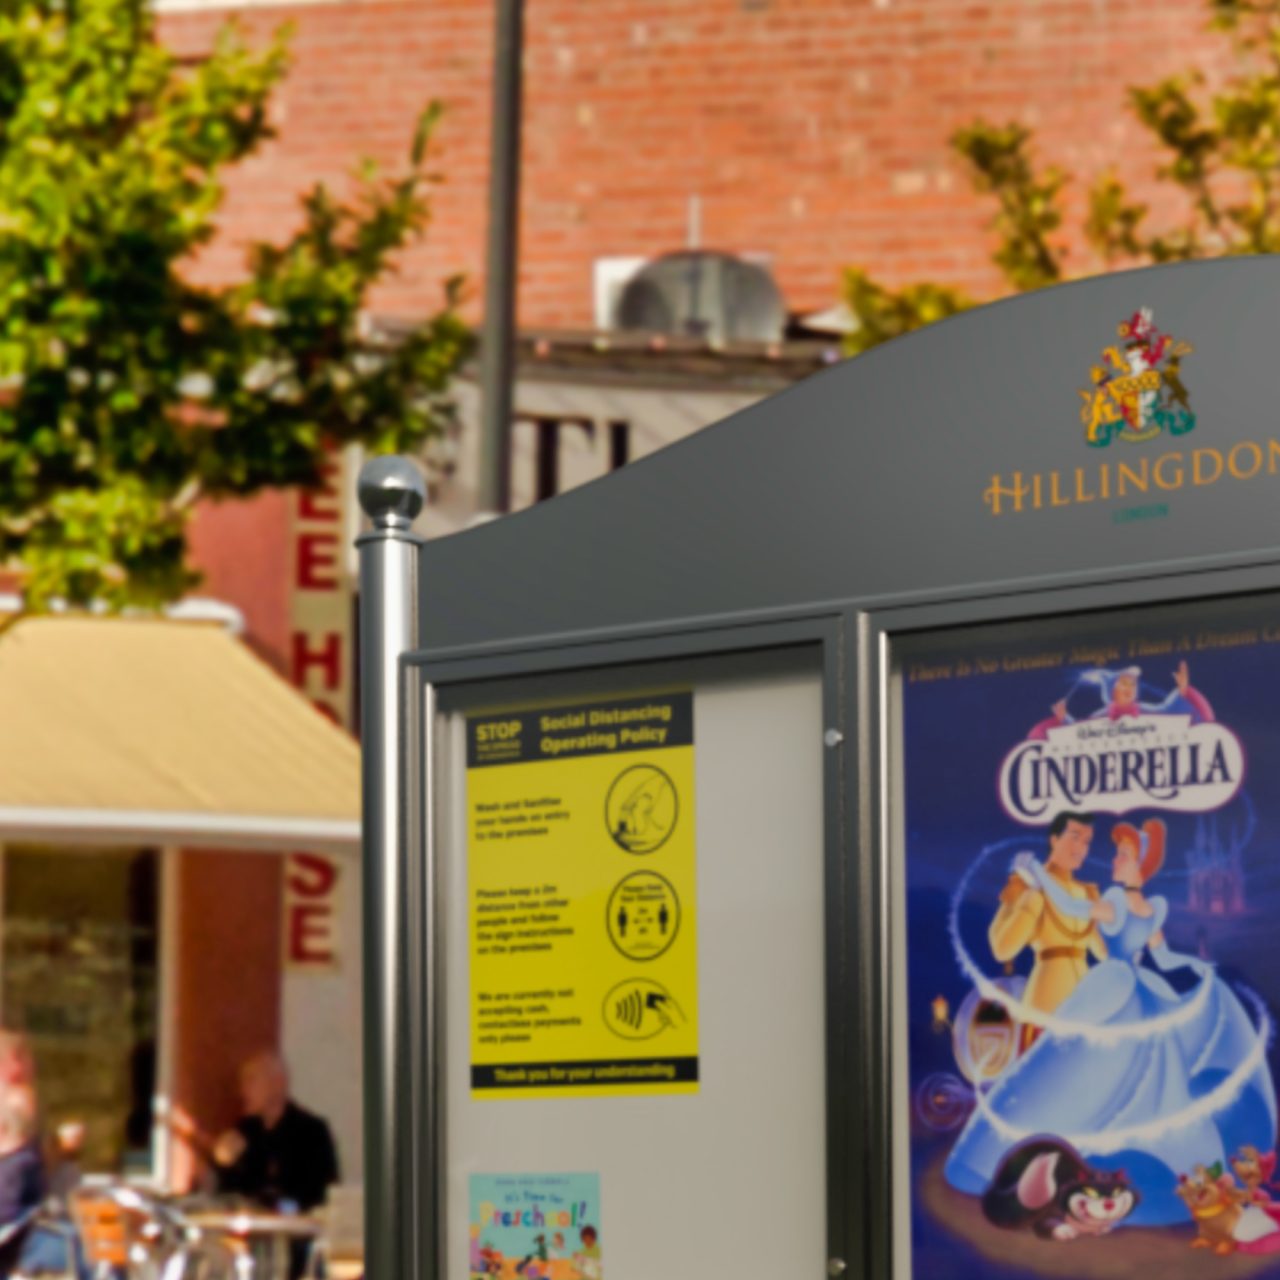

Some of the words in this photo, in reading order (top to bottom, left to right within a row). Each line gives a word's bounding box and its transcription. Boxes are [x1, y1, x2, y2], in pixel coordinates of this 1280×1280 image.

[476, 720, 522, 742] STOP
[540, 711, 585, 732] Social
[589, 704, 672, 727] Distancing
[540, 732, 617, 754] Operating
[621, 726, 668, 745] Policy
[1008, 739, 1234, 817] CINDERELLA
[493, 1068, 526, 1081] Thank
